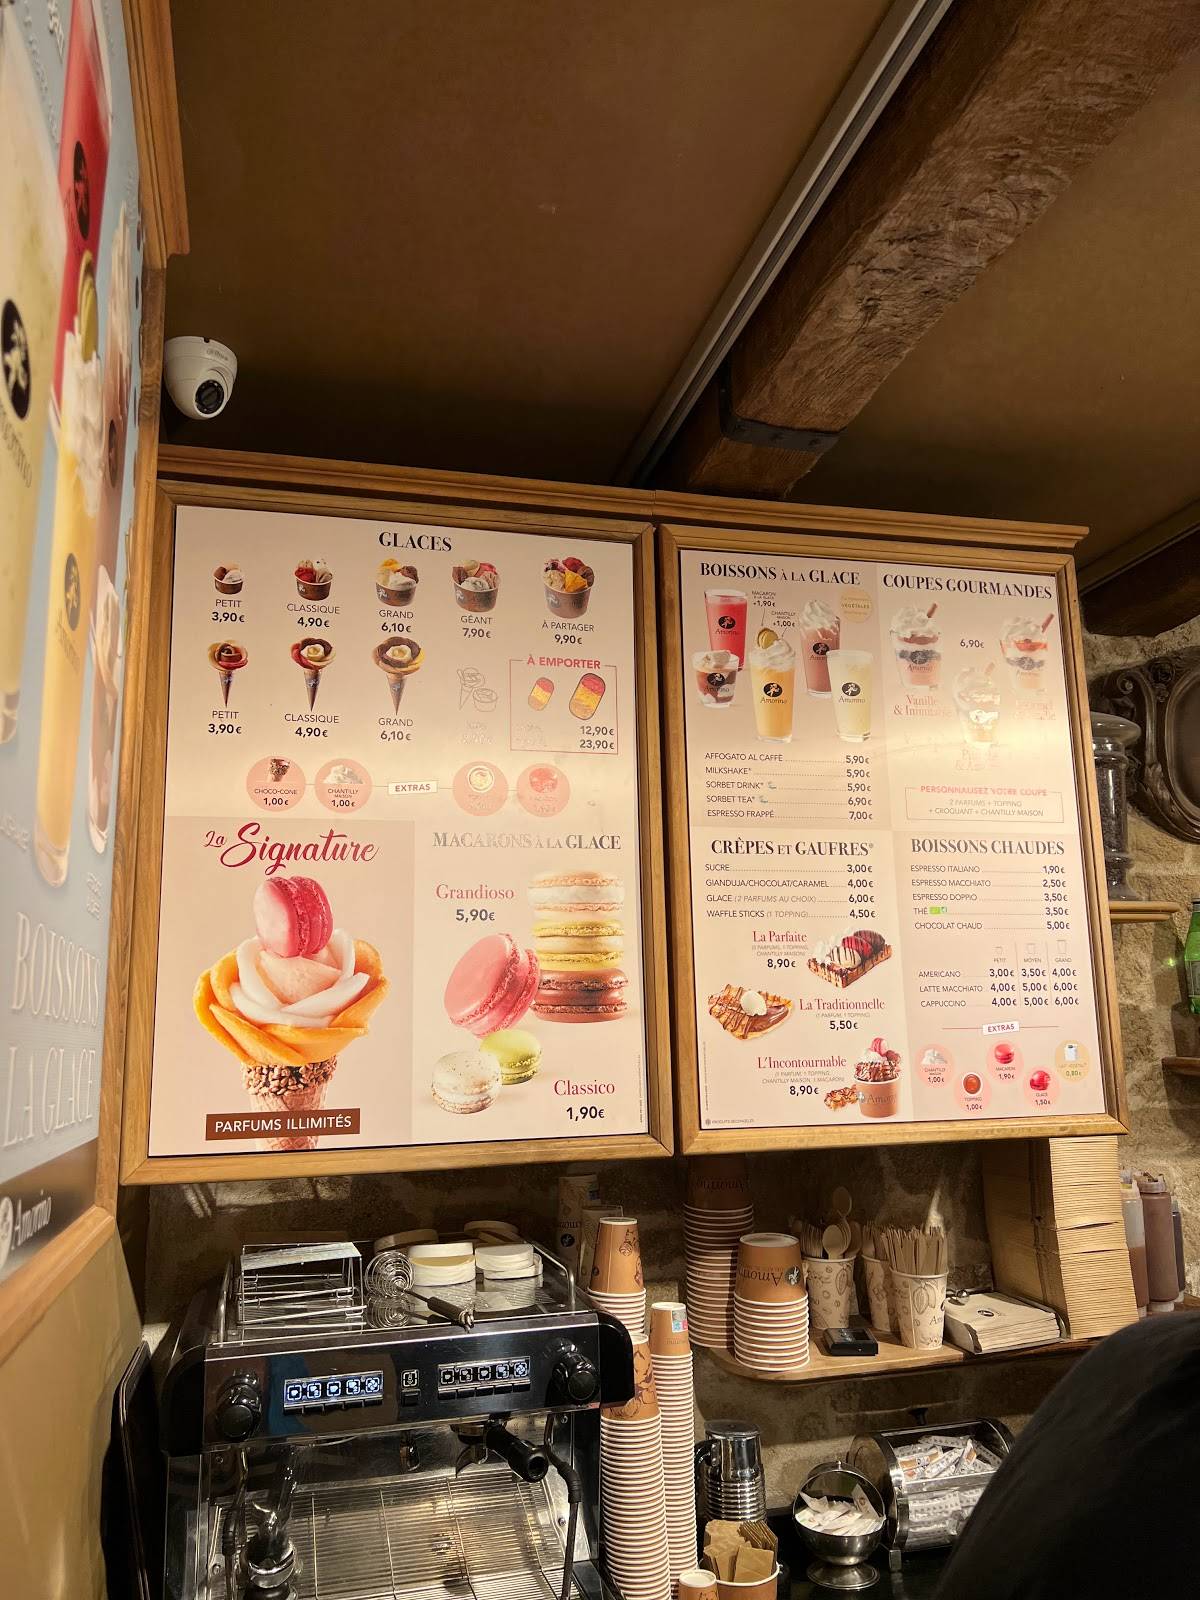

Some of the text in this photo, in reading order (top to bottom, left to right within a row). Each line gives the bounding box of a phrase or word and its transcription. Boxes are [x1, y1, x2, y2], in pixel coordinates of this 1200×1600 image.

[378, 531, 452, 552] GLACES
[700, 562, 861, 585] BOISSONS À LA GLACE
[883, 573, 1052, 600] COUPES GOURMANDES
[215, 598, 242, 608] PETIT
[286, 603, 341, 615] CLASSIQUE
[211, 611, 245, 623] 3,90€
[378, 609, 414, 620] GRAND
[460, 613, 493, 625] GÉANT
[297, 617, 330, 629] 4,90€
[381, 622, 412, 634] 6,10€
[541, 620, 595, 632] À PARTAGER
[462, 627, 491, 639] 7,90€
[554, 634, 582, 645] 9,90€
[960, 638, 985, 648] 6,90€
[527, 653, 601, 669] À EMPORTER
[212, 710, 239, 720] PETIT
[284, 713, 339, 725] CLASSIQUE
[378, 717, 413, 727] GRAND
[208, 723, 242, 735] 3,90€
[295, 726, 328, 738] 4,90€
[579, 725, 614, 737] 12,90€
[380, 731, 411, 742] 6,10€
[579, 739, 614, 751] 23,90€
[704, 752, 747, 761] AFFOGATO
[845, 755, 870, 765] 5,90€
[846, 769, 871, 779] 5,90€
[327, 787, 359, 795] CHANTILLY
[395, 783, 431, 793] EXTRAS
[705, 781, 735, 789] SORBET
[847, 783, 872, 793] 5,90€
[920, 785, 1048, 797] PERSONNALISEZ VOTRE COUPE
[263, 797, 289, 807] 1,00€
[331, 799, 355, 808] 1,00€
[706, 795, 736, 803] SORBET
[848, 797, 873, 807] 6,90€
[707, 809, 873, 821] ESPRESSO FRAPPÉ 7,00€
[934, 807, 1044, 817] CROQUANT CHANTILLY MAISON
[432, 832, 534, 849] MACARONS
[546, 837, 563, 849] LA
[565, 834, 622, 850] GLACE
[711, 837, 774, 855] CRÊPES
[777, 844, 792, 855] ET
[911, 838, 1065, 856] BOISSONS CHAUDES
[202, 822, 380, 876] La Signature
[704, 864, 873, 874] SUCRE 3,00€
[910, 864, 1065, 875] ESPRESSO ITALIANO 1,90€
[705, 879, 874, 889] GIANDUJA/CHOCOLAT/CARAMEL 4,00€
[911, 879, 1067, 889] ESPRESSO MACCHIATO 2,50€
[436, 884, 515, 900] Grandioso
[912, 893, 1068, 902] ESPRESSO DOPPIO 3,50€
[706, 894, 733, 902] GLACE
[743, 895, 777, 903] PARFUMS
[848, 894, 875, 904] 6,00€
[455, 908, 496, 923] 5,90€
[706, 910, 738, 918] WAFFLE
[739, 910, 765, 918] STICKS
[849, 909, 876, 919] 4,50€
[914, 906, 929, 915] THÉ
[1045, 907, 1069, 917] 3,50€
[914, 921, 1071, 931] CHOCOLAT CHAUD 5,00€
[753, 931, 808, 943] La Parfaite
[11, 911, 100, 1028] BOISSONS
[767, 958, 796, 969] 8,90€
[918, 967, 1077, 978] AMERICANO 3,00€ 3,50€ 4,00€
[919, 982, 1078, 993] LATTE MACCHIATO 4,00€ 5,00€ 6,00€
[800, 998, 885, 1011] La Traditionnelle
[920, 996, 1080, 1008] CAPPUCCINO 4,00€ 5,00€ 6,00€
[829, 1020, 858, 1031] 5,50€
[987, 1023, 1015, 1033] EXTRAS
[758, 1056, 847, 1070] L'Incontournable
[42, 1046, 96, 1137] GLACE
[553, 1079, 616, 1096] Classico
[789, 1085, 819, 1096] 8,90€
[565, 1105, 605, 1122] 1,90€
[214, 1112, 353, 1135] PARFUMS ILLIMITÉS
